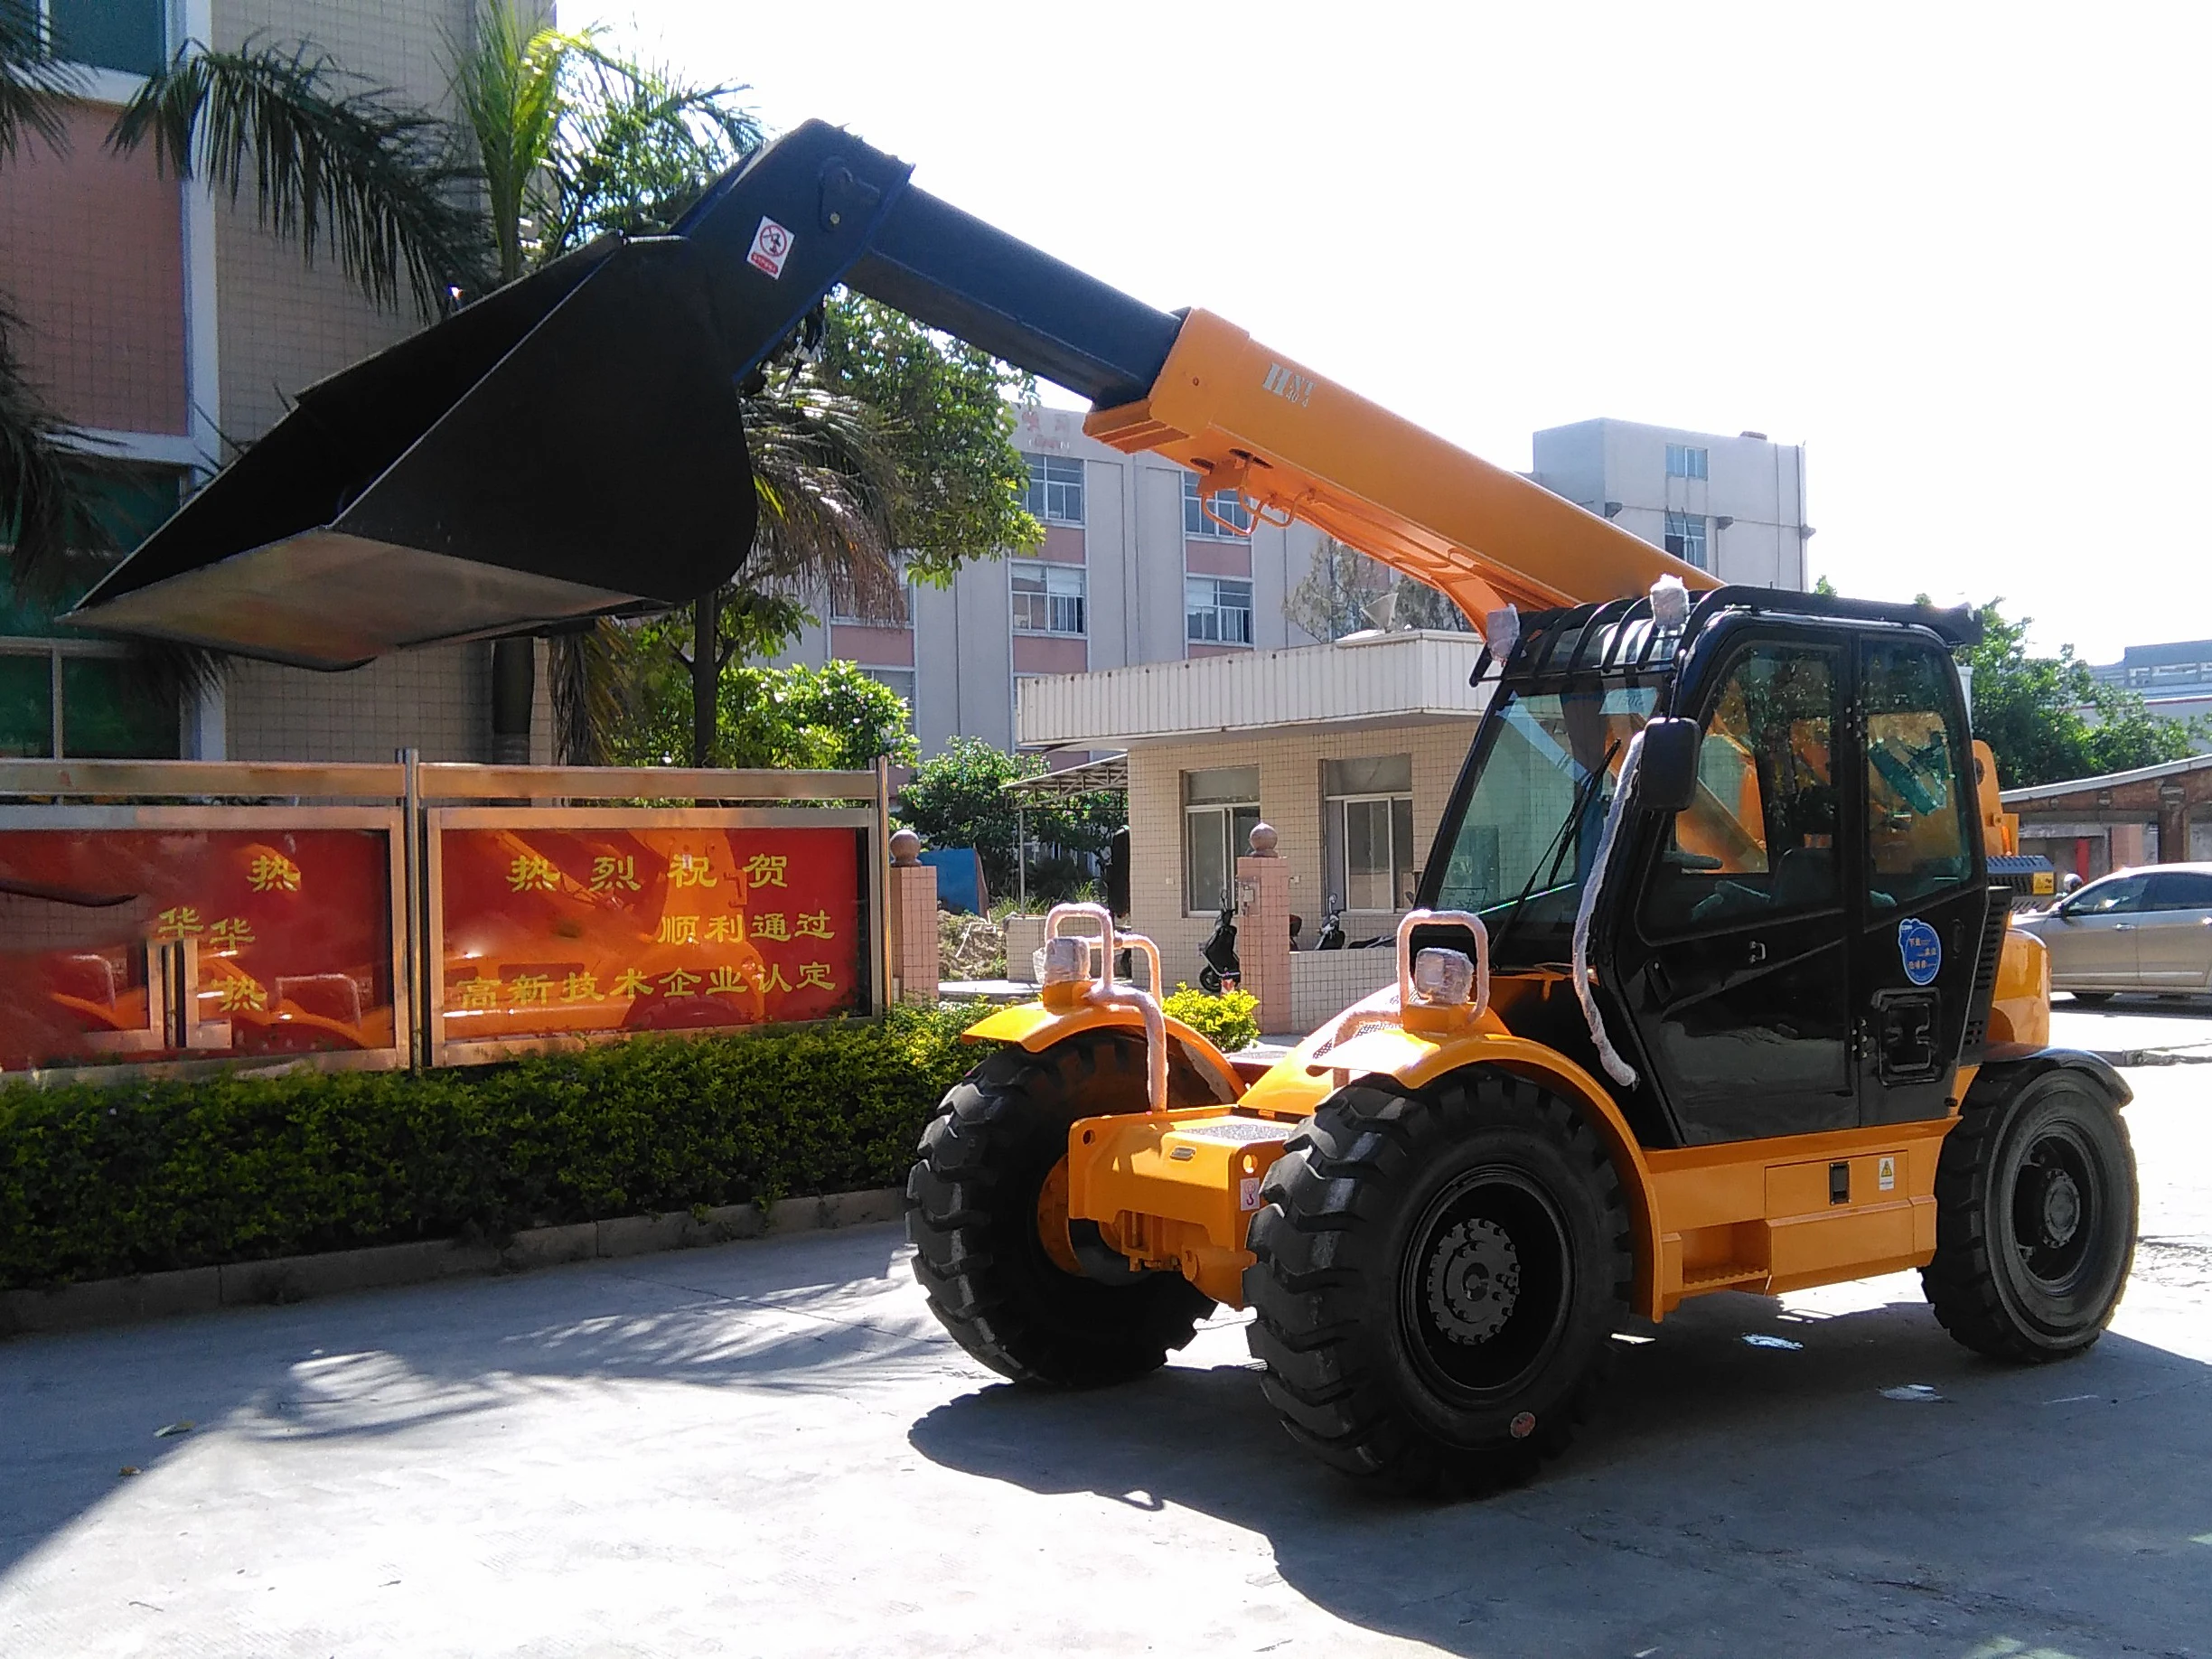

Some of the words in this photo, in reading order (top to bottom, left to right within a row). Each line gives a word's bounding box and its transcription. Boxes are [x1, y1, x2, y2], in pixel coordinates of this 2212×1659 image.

[505, 852, 789, 893] 热烈祝贺
[656, 909, 836, 945] 顺利通过
[455, 961, 837, 1008] 高新技术企业认定
